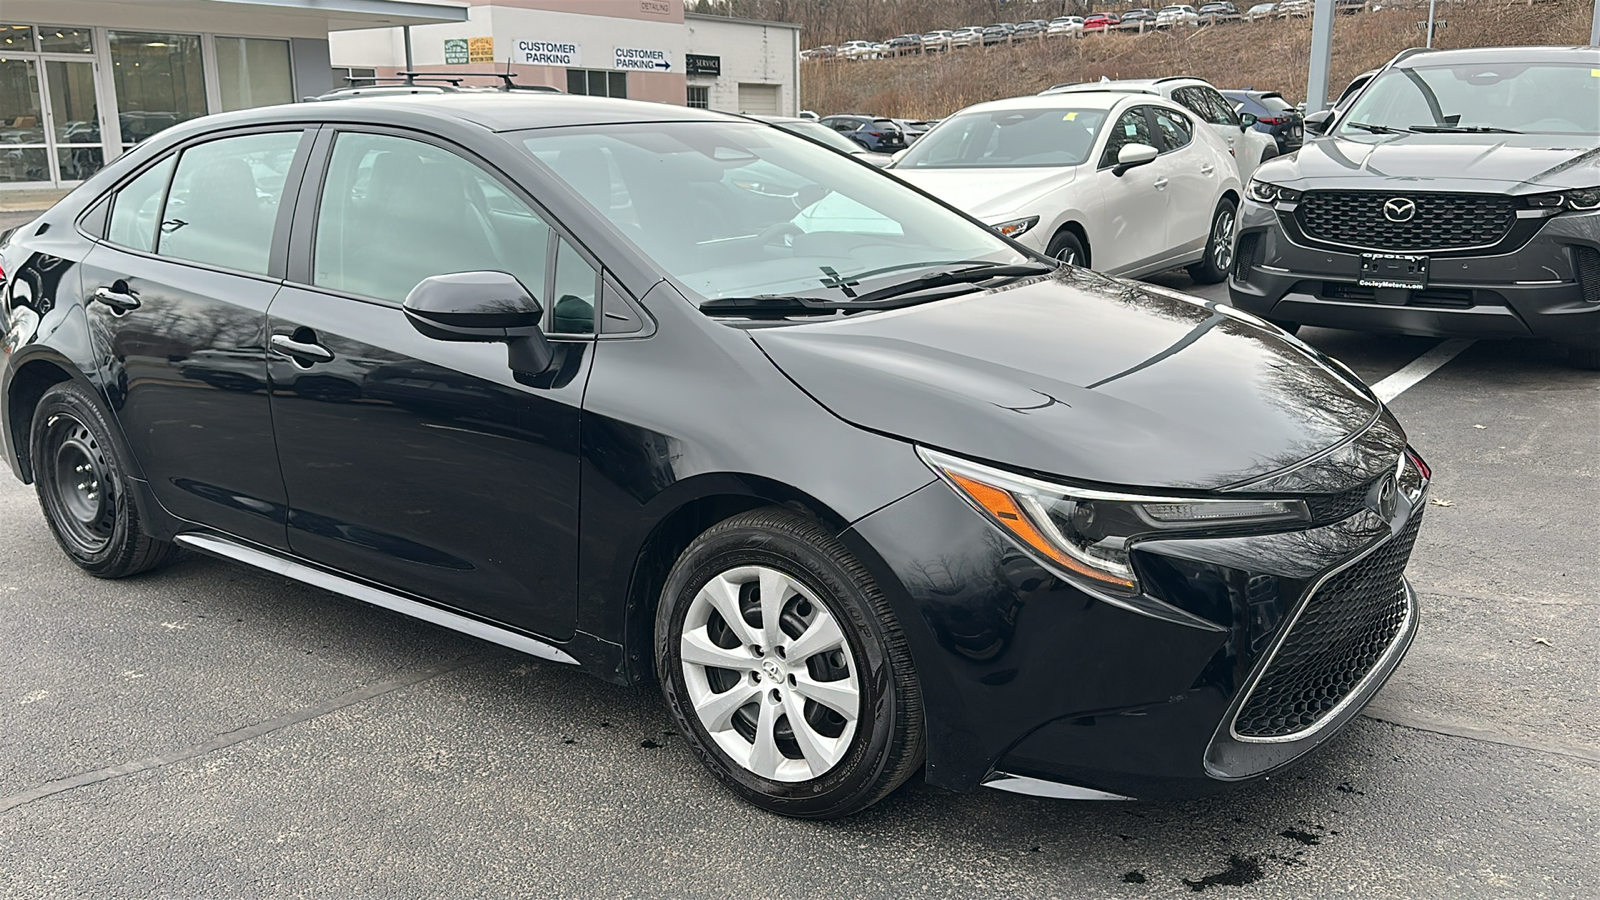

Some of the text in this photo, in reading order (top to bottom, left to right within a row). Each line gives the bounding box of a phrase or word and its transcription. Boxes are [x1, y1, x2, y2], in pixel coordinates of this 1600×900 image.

[641, 2, 669, 12] DETAILING
[470, 38, 492, 46] OFFICIAL
[519, 41, 576, 54] CUSTOMER
[526, 52, 570, 64] PARKING
[615, 48, 664, 60] CUSTOMER
[616, 59, 654, 70] PARKING
[696, 59, 719, 68] SERVICE
[1359, 280, 1423, 289] CooleyMotors.com
[805, 560, 872, 638] DUNLOP
